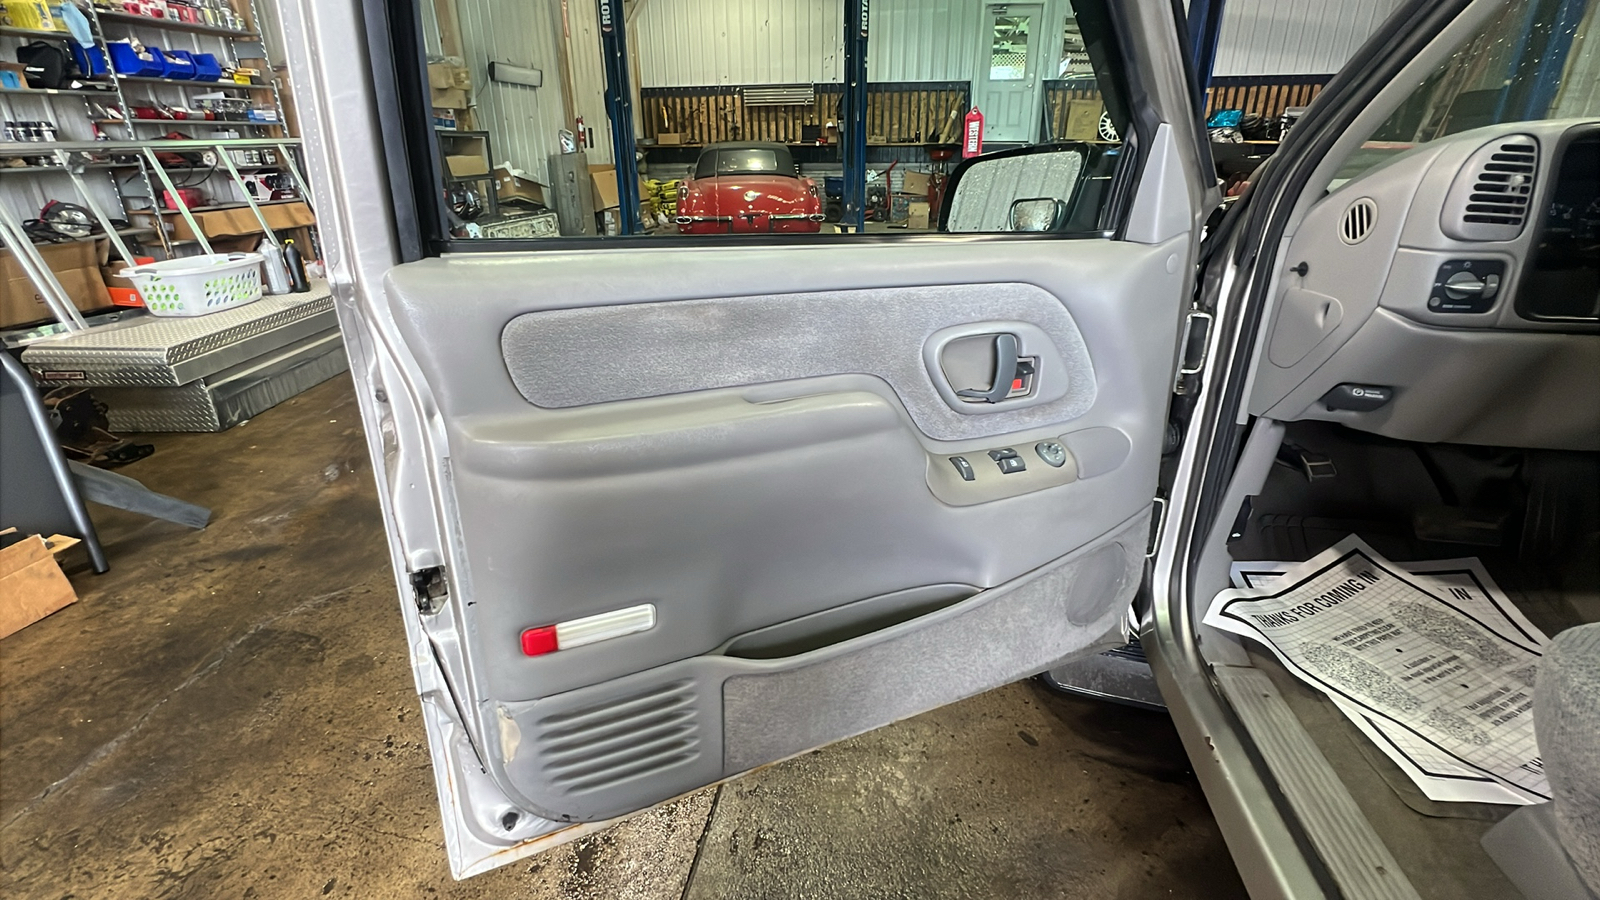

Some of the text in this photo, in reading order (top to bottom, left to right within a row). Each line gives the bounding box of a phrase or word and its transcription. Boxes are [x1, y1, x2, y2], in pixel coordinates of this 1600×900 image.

[967, 121, 980, 152] WESTERN
[1251, 570, 1380, 628] THANKS FOR COMING IN
[1448, 587, 1473, 600] IN
